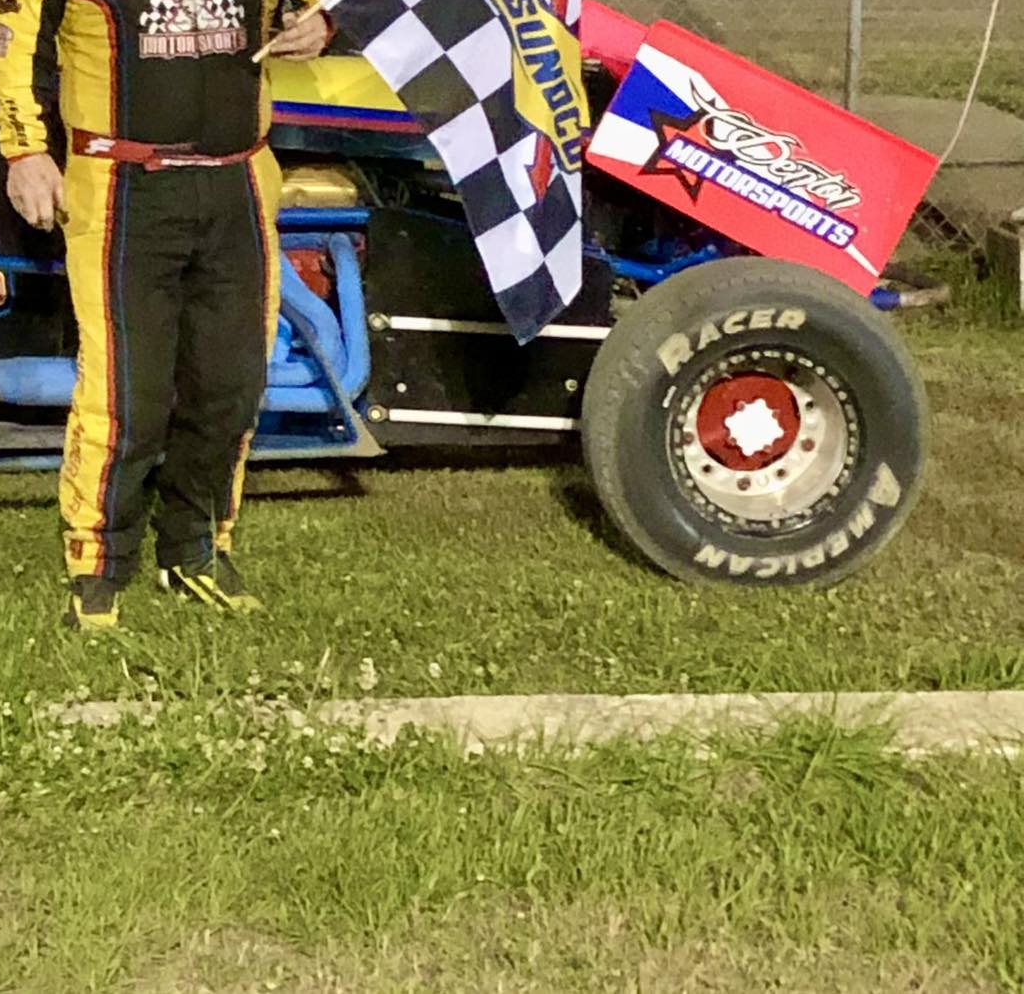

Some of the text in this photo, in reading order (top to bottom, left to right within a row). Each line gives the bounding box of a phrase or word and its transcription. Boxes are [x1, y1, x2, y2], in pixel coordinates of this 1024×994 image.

[664, 138, 856, 246] MOTORSPORTS
[657, 308, 806, 376] RACER
[694, 462, 901, 578] AMERICAN
